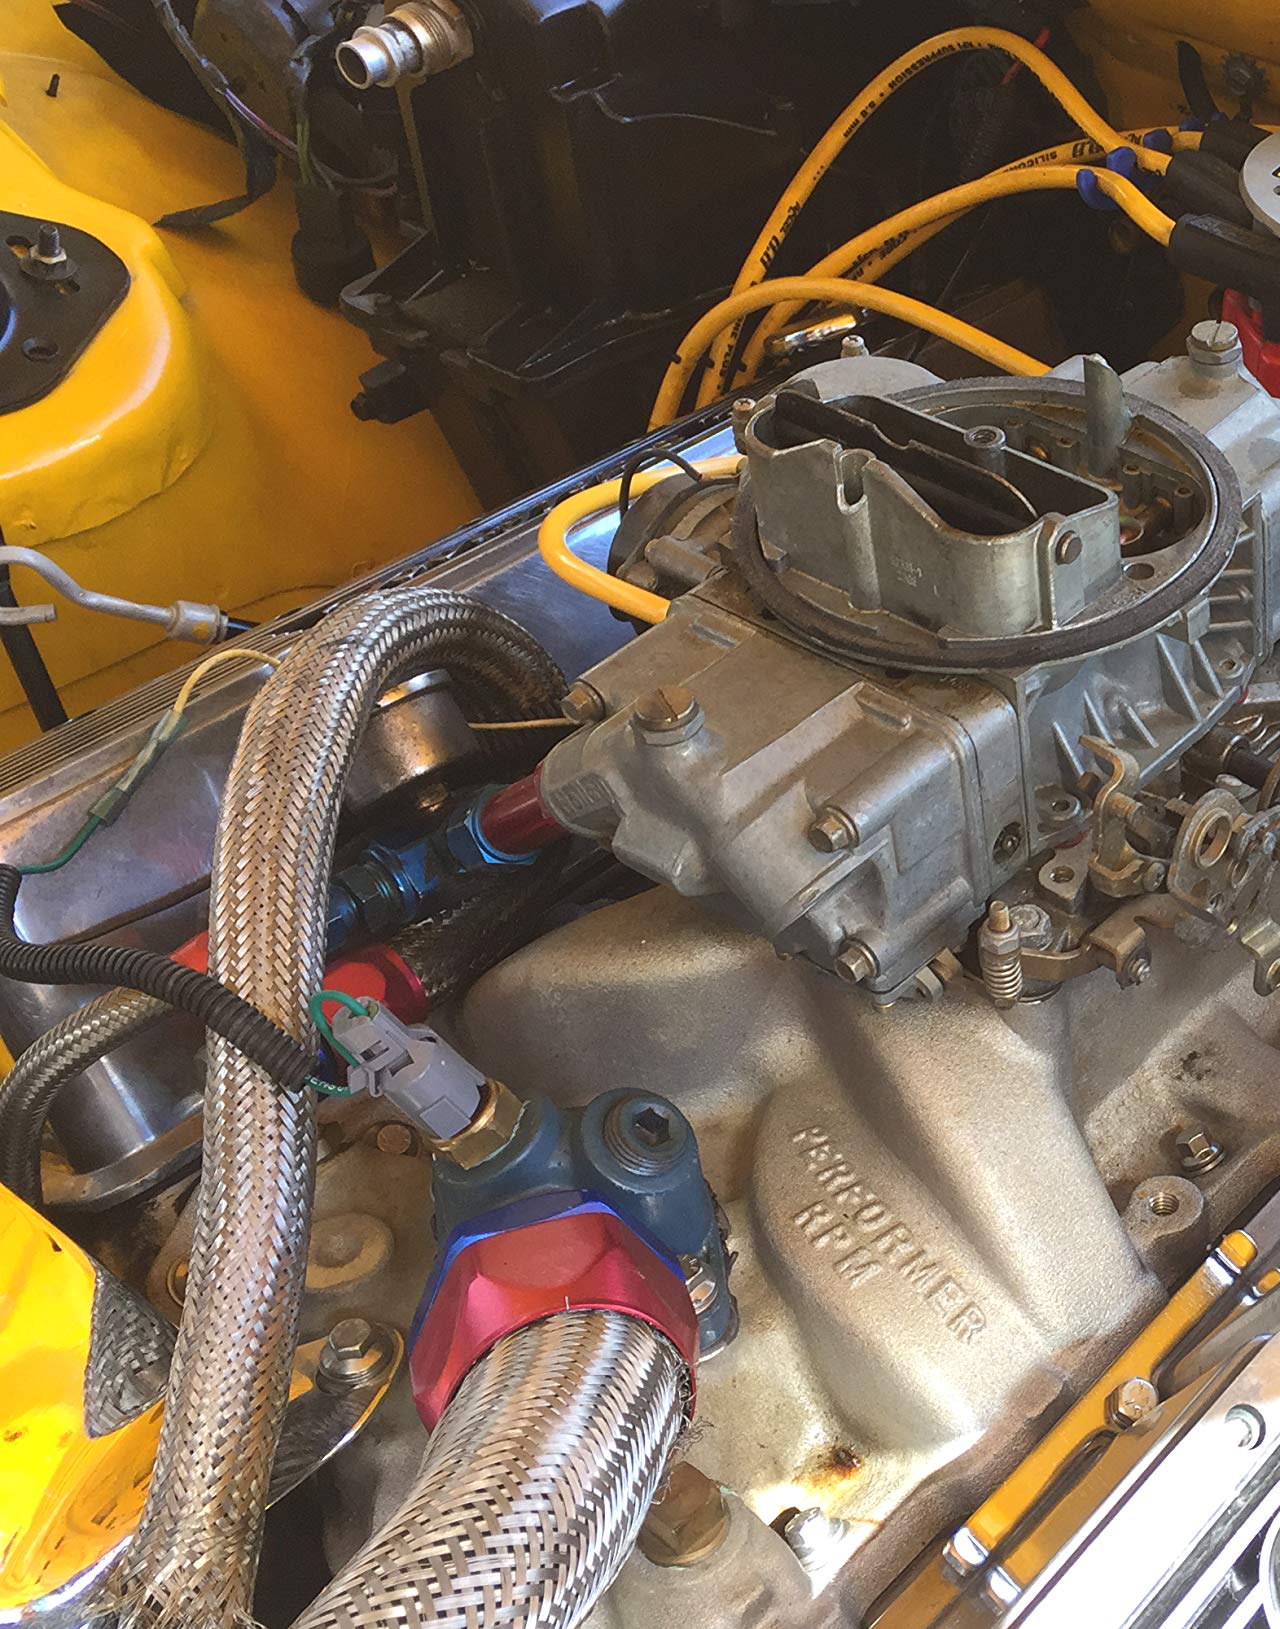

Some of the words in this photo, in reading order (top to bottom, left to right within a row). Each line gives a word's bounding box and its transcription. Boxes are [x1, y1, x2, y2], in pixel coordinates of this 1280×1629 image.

[888, 43, 956, 91] SUPPRESSION
[1004, 151, 1058, 173] SILICO
[791, 1127, 987, 1343] PERFORMER
[793, 1199, 882, 1289] RPM
